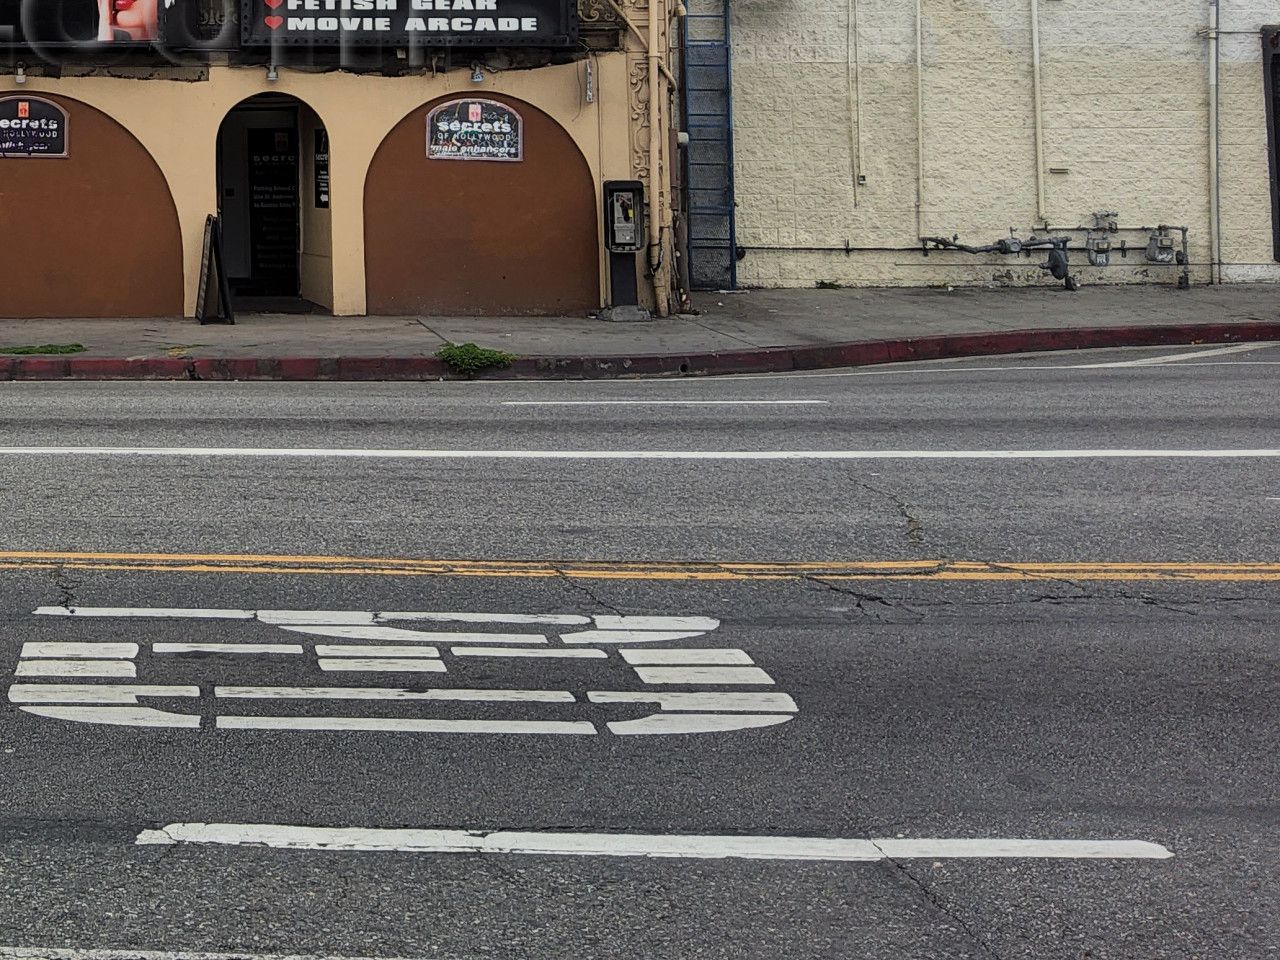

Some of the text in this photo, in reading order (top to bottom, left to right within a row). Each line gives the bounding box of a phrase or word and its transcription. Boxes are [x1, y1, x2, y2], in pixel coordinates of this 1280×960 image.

[287, 17, 538, 31] MOVIE ARCADE
[437, 120, 512, 132] secrets
